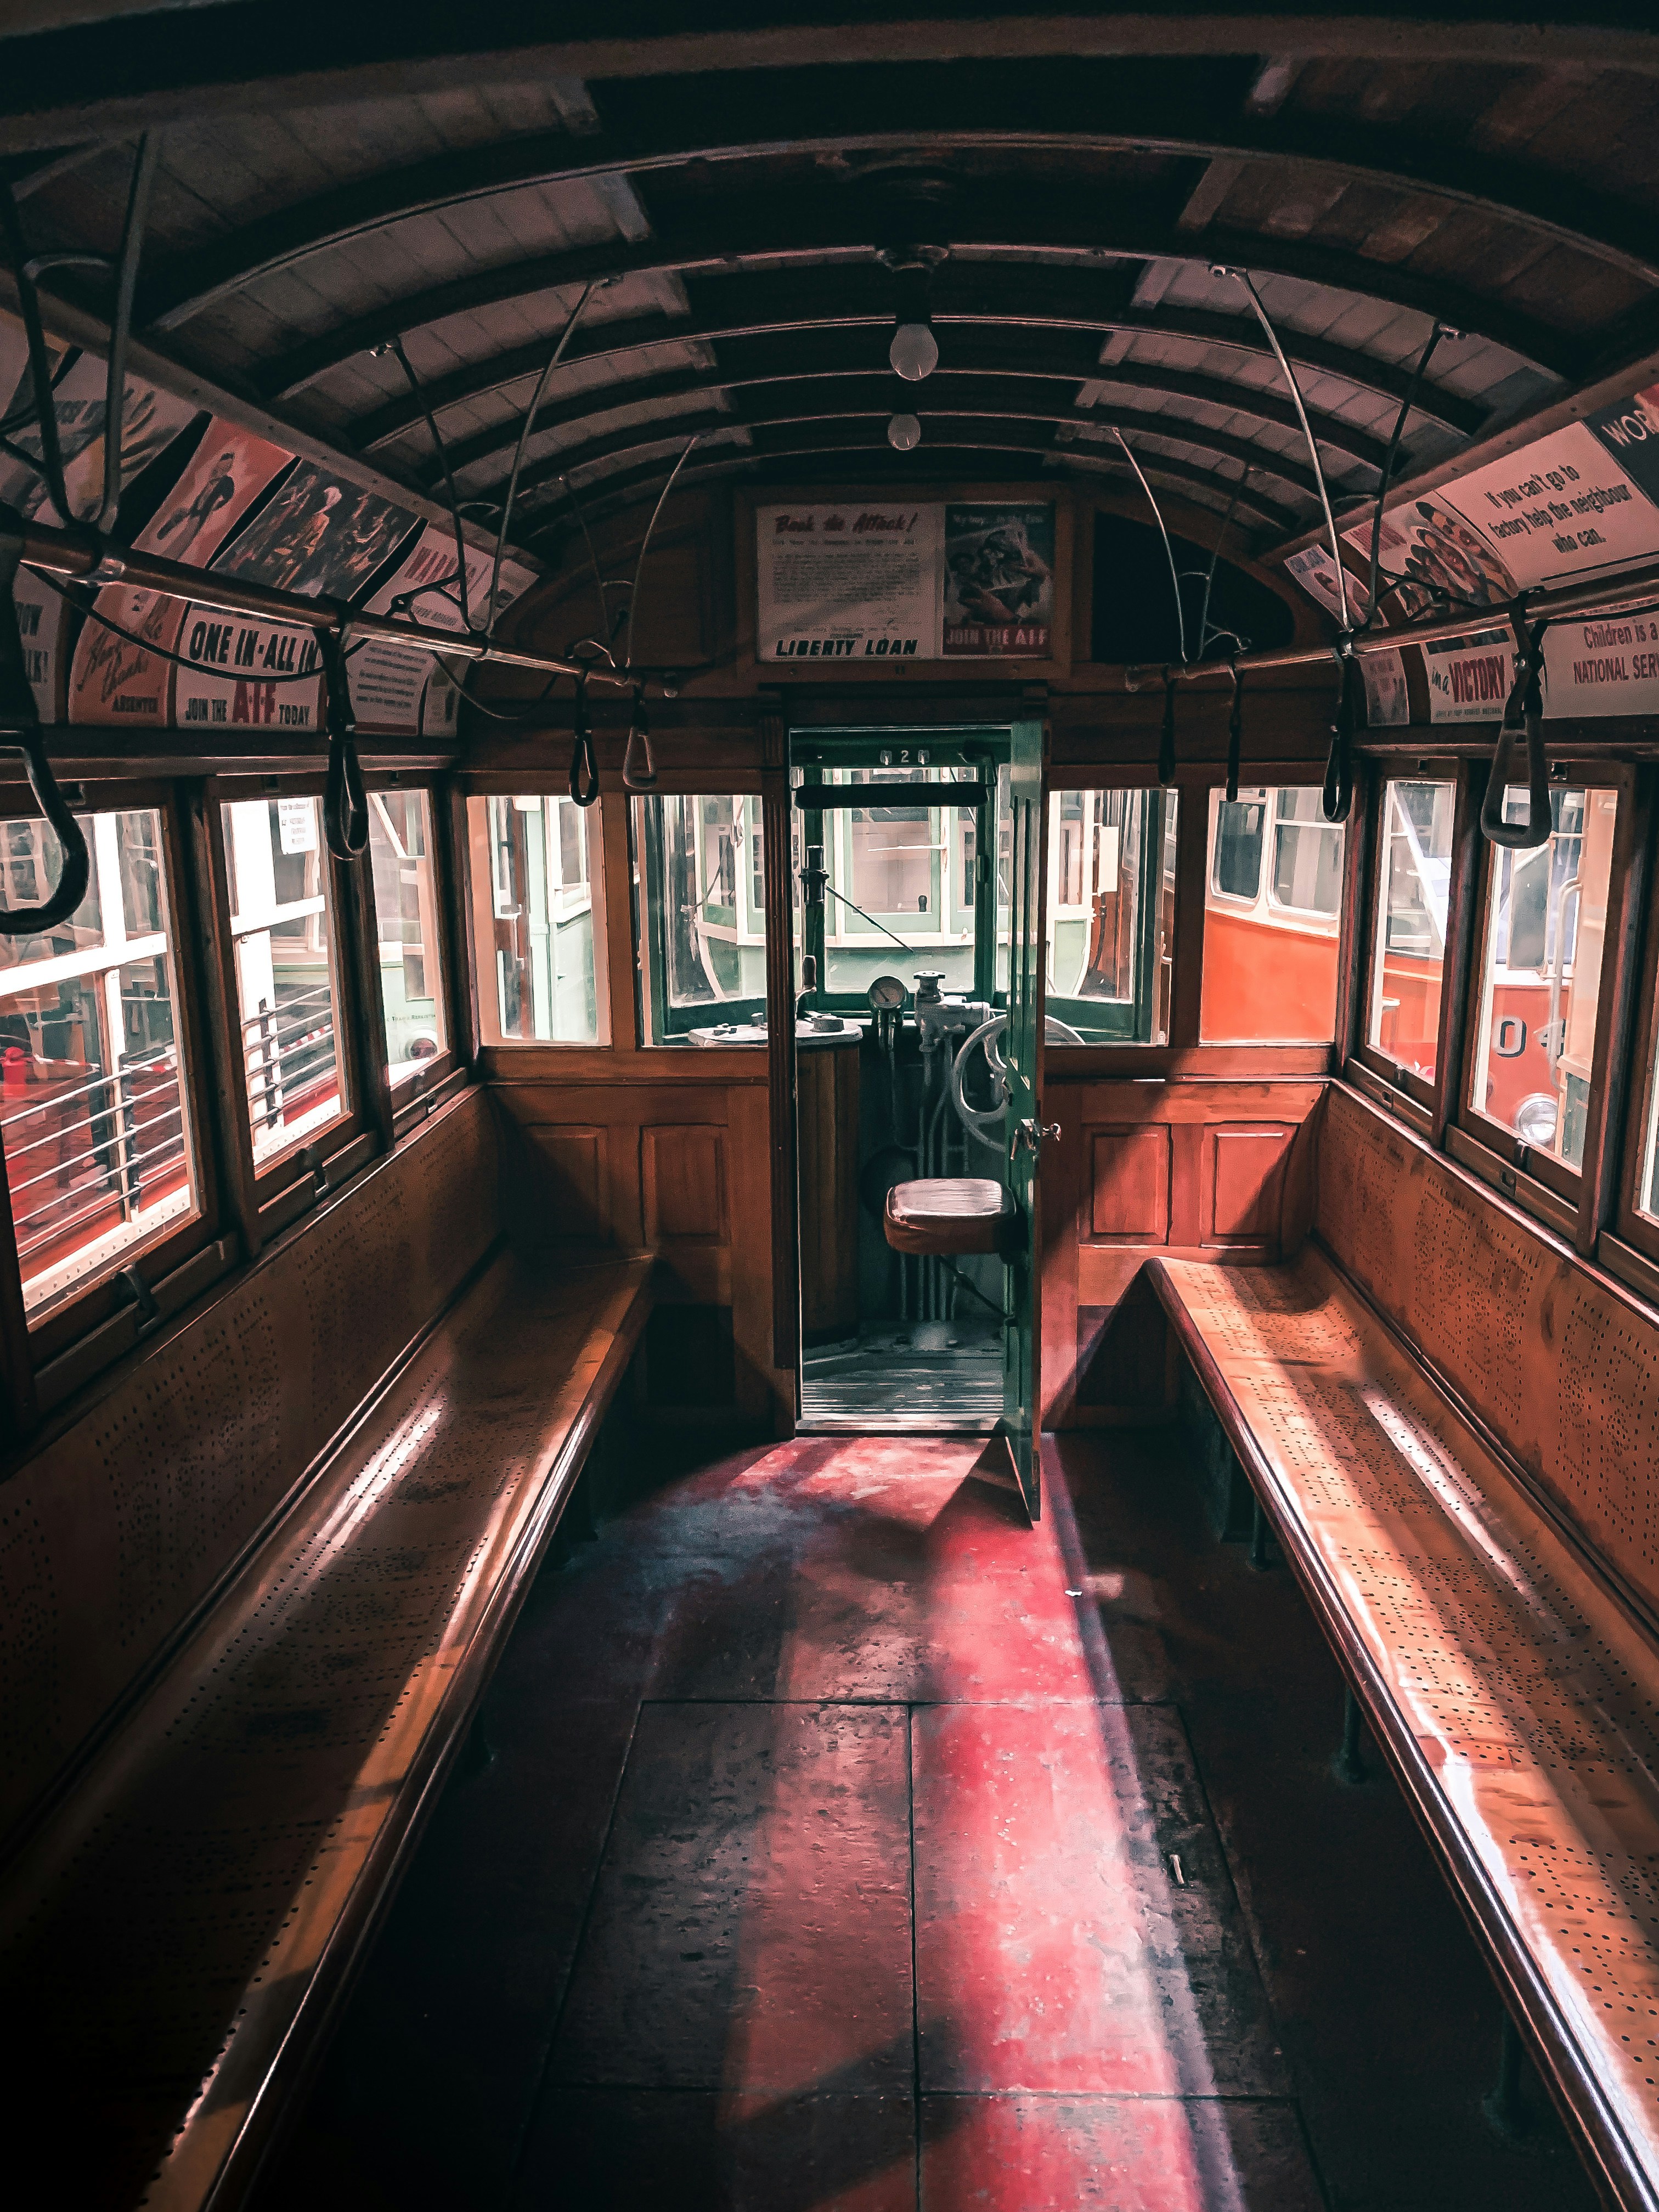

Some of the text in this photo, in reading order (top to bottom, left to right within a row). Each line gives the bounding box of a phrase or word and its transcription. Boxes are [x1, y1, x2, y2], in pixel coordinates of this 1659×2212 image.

[1483, 465, 1580, 509] If you can't go to
[1488, 484, 1633, 539] factory help the neighbour
[1551, 528, 1607, 554] who can.
[189, 621, 234, 664] ONE
[776, 639, 917, 656] LIBERTY LOAN
[946, 629, 979, 645] JOIN
[984, 629, 1009, 645] THE
[1583, 619, 1658, 649] Children is a
[1448, 654, 1505, 703] VICTORY
[1573, 657, 1629, 684] NATIONAL
[185, 698, 208, 721] JOIN
[211, 699, 227, 723] THE
[279, 704, 310, 726] TODAY
